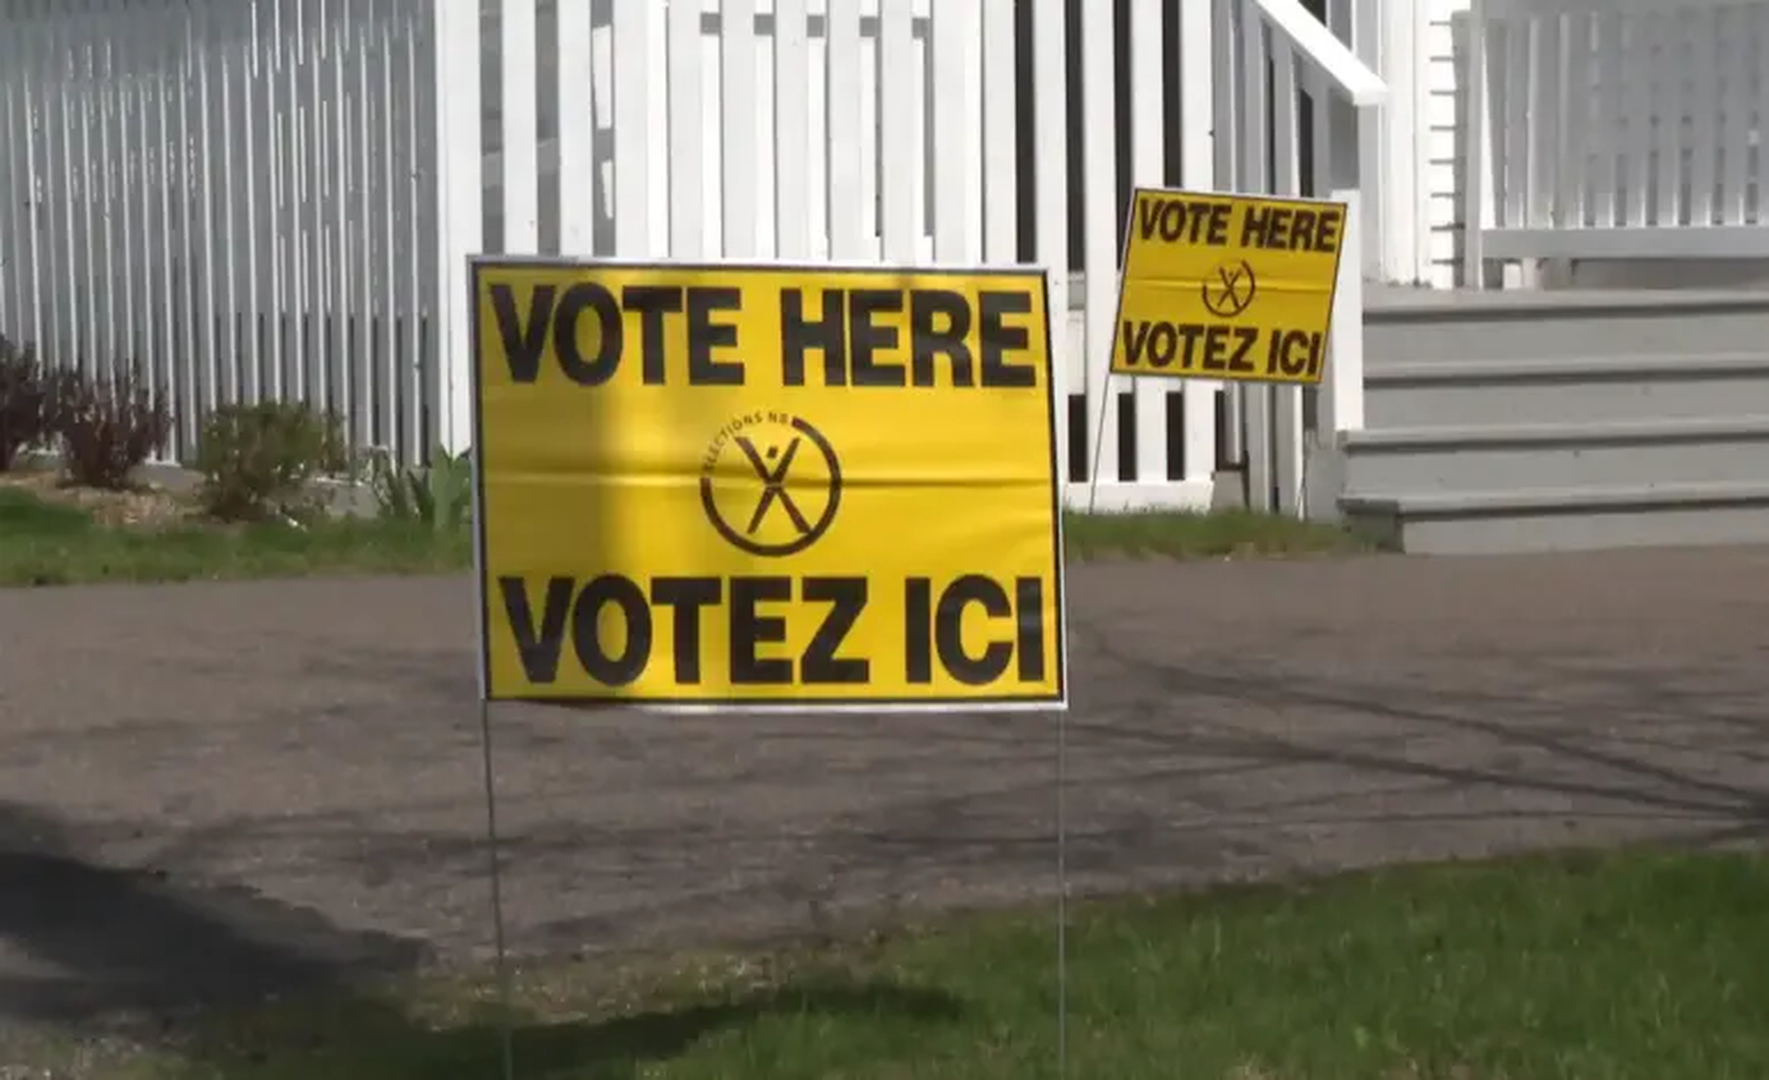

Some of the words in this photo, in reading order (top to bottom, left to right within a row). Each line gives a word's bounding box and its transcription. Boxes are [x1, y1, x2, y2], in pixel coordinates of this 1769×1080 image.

[1140, 199, 1232, 246] VOTE
[1240, 206, 1339, 252] HERE
[490, 282, 745, 385] VOTE
[780, 287, 1036, 387] HERE
[1123, 321, 1258, 372] VOTEZ
[1267, 329, 1322, 376] ICI
[702, 411, 763, 471] ELECTIONS
[499, 574, 870, 686] VOTEZ
[905, 574, 1044, 685] ICI
